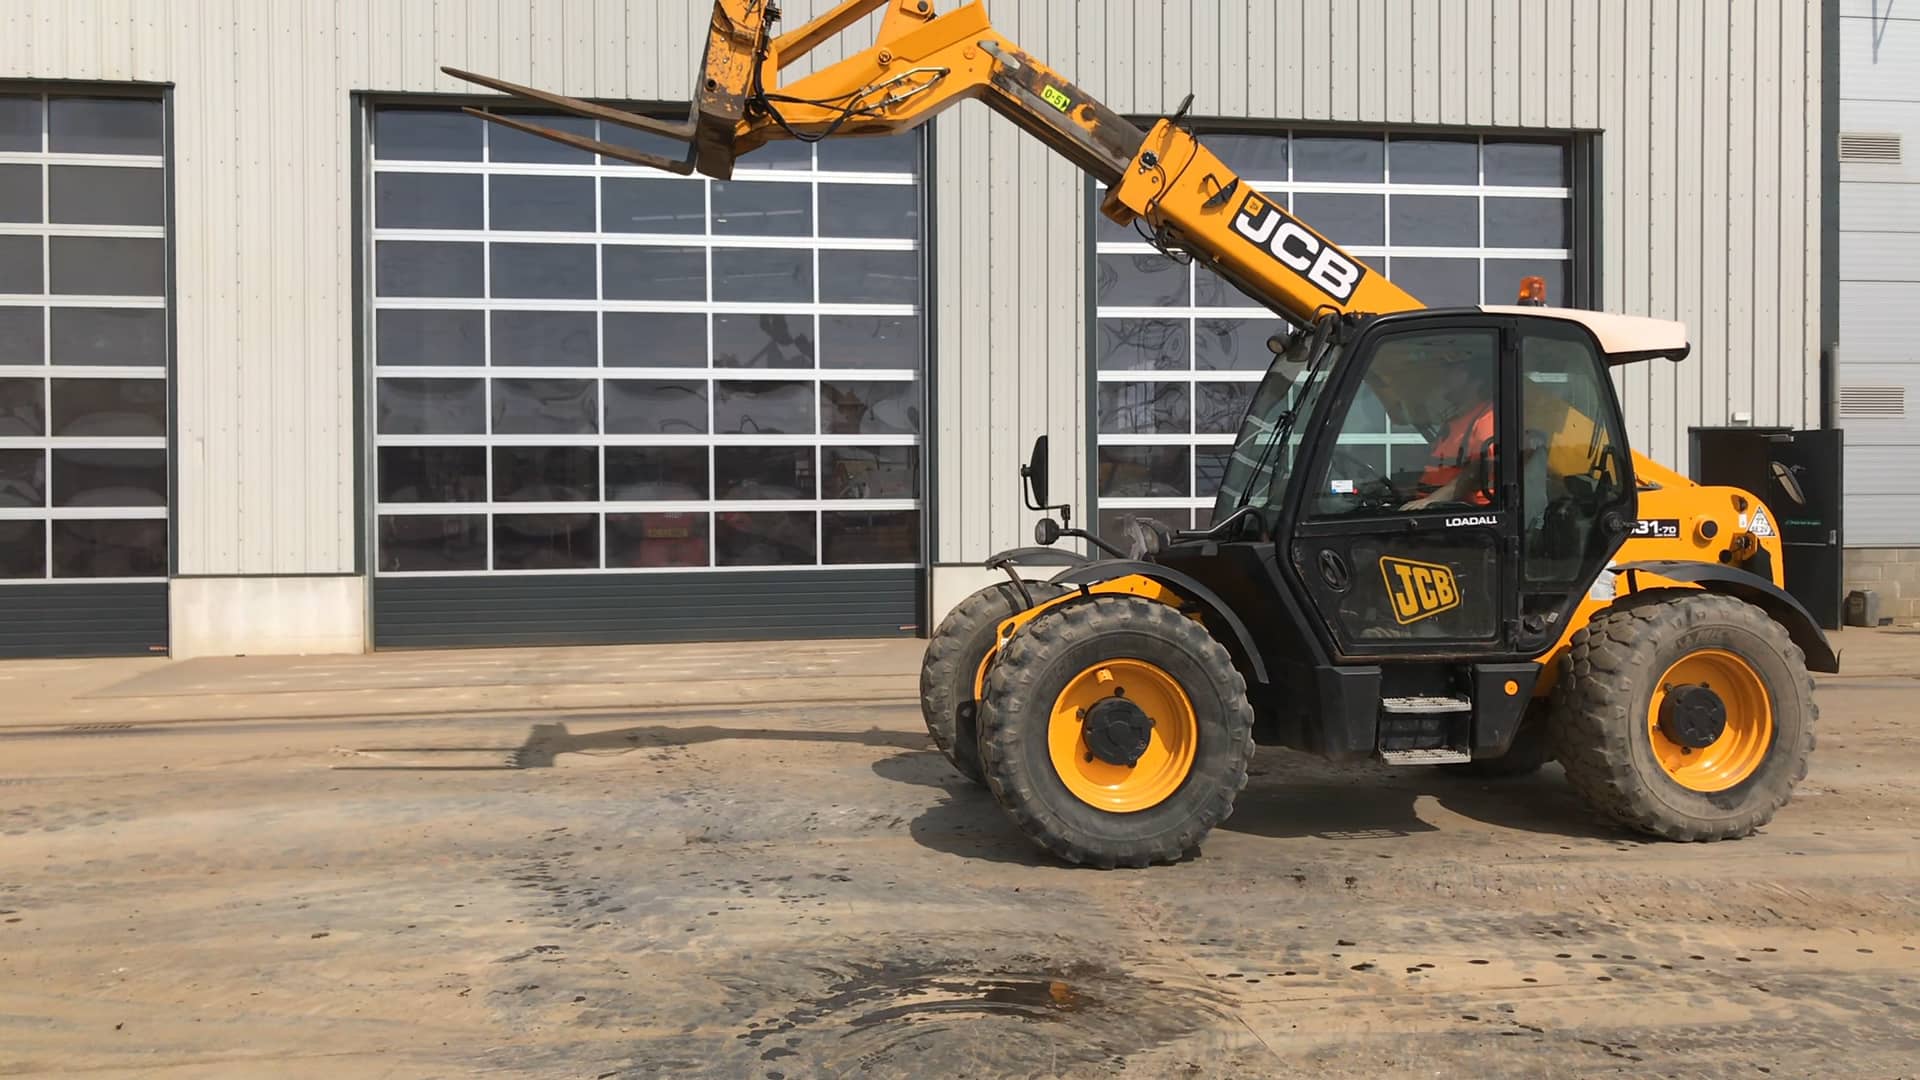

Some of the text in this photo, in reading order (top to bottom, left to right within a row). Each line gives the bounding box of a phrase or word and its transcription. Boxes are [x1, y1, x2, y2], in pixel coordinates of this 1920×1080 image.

[1235, 209, 1359, 299] JCB
[1446, 515, 1497, 527] LOADALL
[1631, 520, 1677, 534] 31-70
[1394, 564, 1454, 616] JCB
